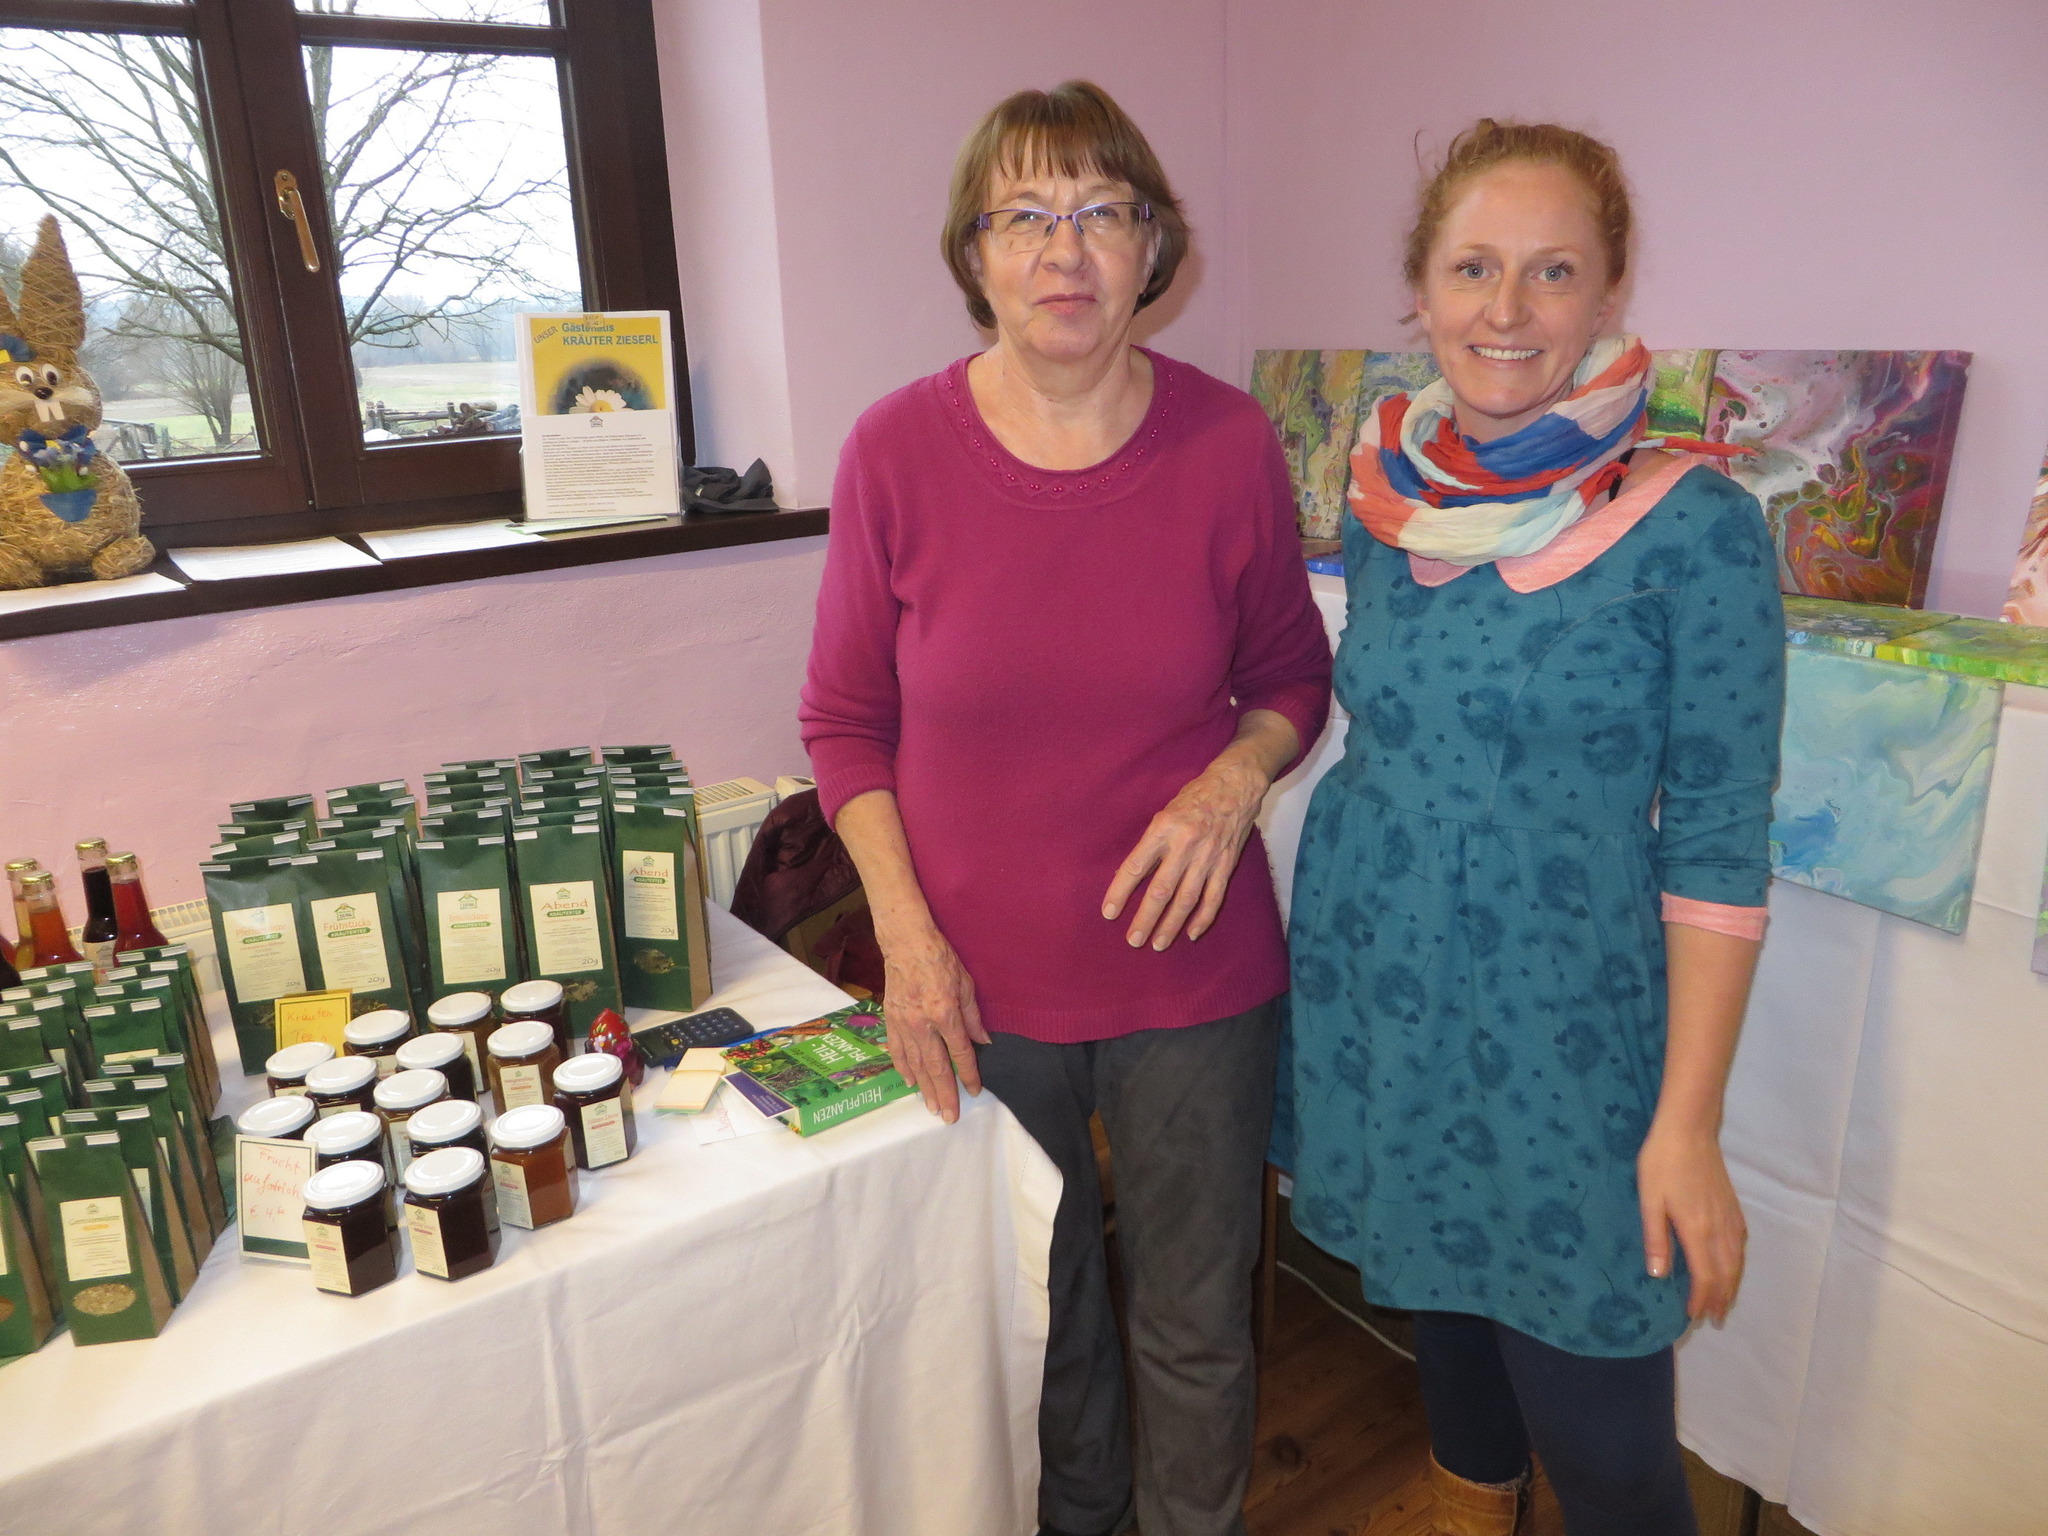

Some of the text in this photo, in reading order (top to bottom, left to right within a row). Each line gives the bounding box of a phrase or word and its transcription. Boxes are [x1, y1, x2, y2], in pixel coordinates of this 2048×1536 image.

[533, 326, 559, 344] UNSER
[562, 334, 659, 346] KRÄUTER ZIESERL
[629, 867, 669, 877] Abend
[541, 899, 589, 911] Abend
[549, 909, 582, 917] KRÄUTERTEE
[819, 1032, 872, 1062] PFLANZEN
[811, 1043, 844, 1064] HEIL-
